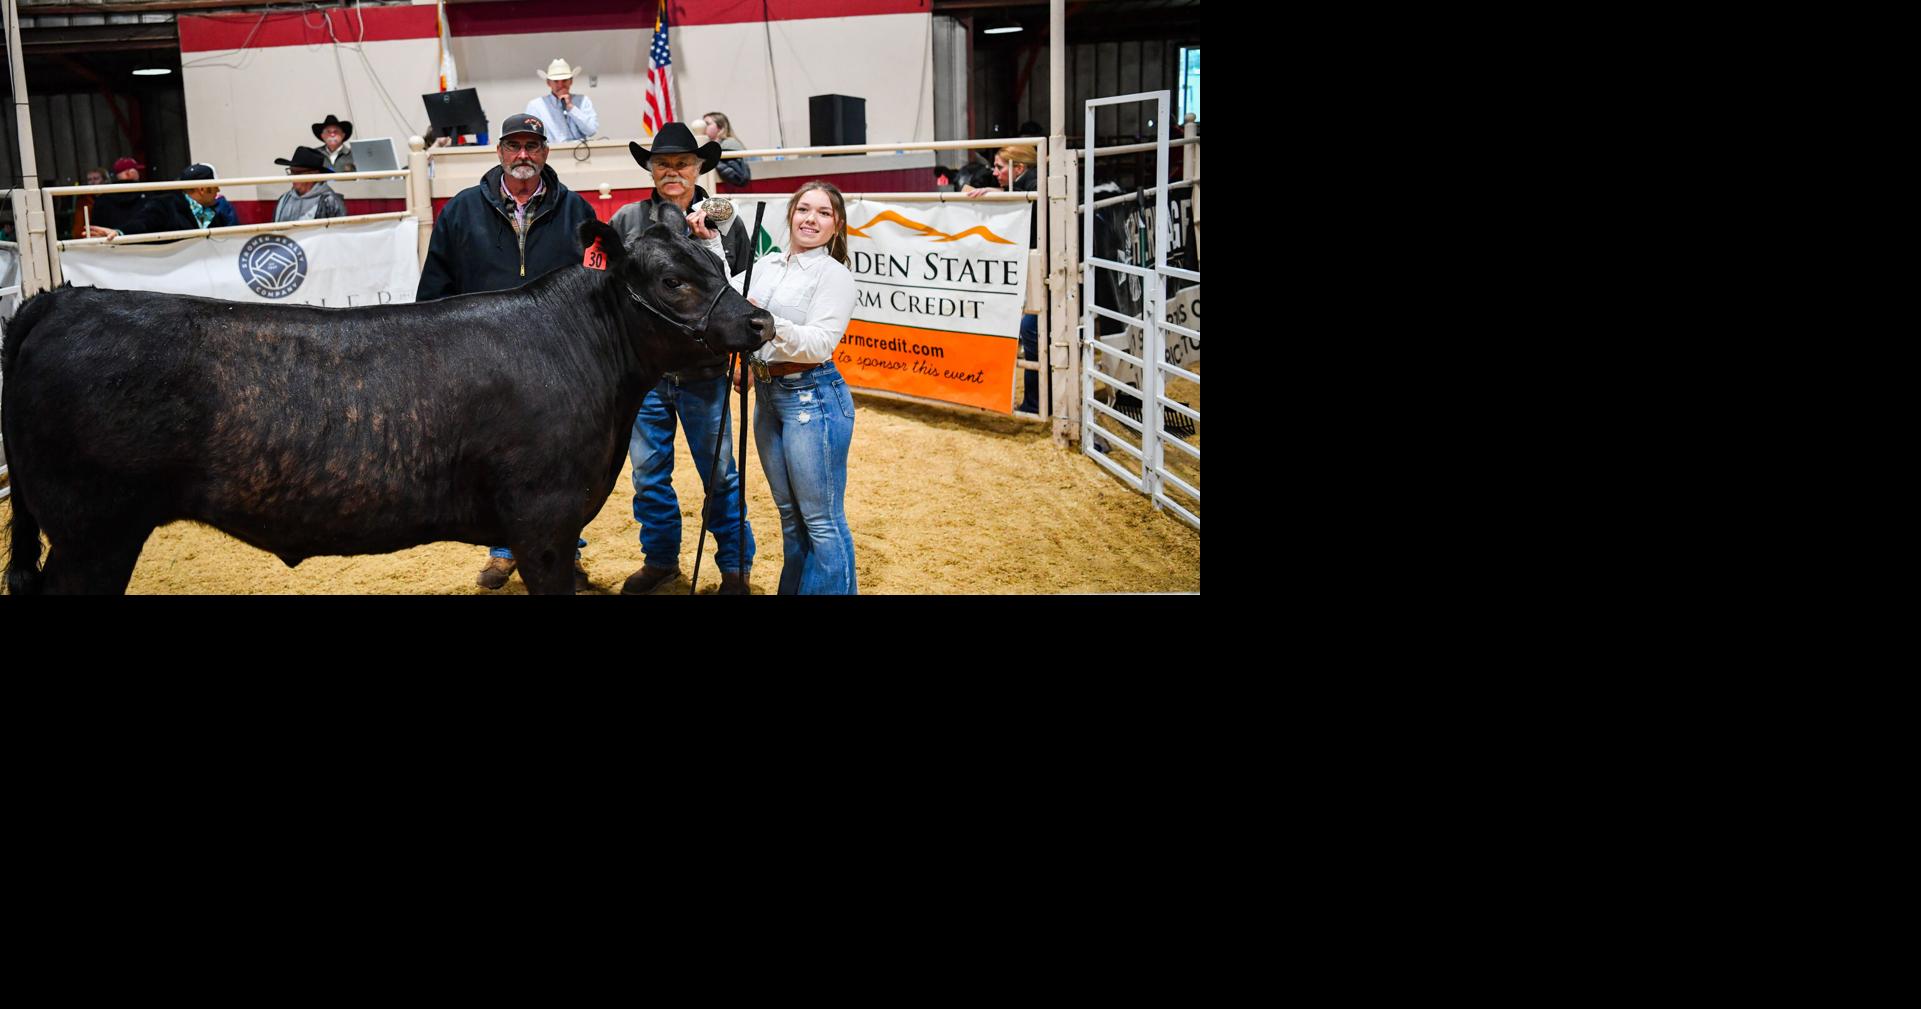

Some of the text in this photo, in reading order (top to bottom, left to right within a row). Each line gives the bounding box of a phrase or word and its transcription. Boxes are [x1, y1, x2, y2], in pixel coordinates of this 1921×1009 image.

[589, 252, 602, 268] 30
[854, 251, 1019, 286] DEN STATE
[256, 282, 297, 297] COMPANY
[856, 289, 985, 319] RM CREDIT
[839, 334, 945, 358] armcredit.com
[838, 350, 984, 384] to sponsor this event
